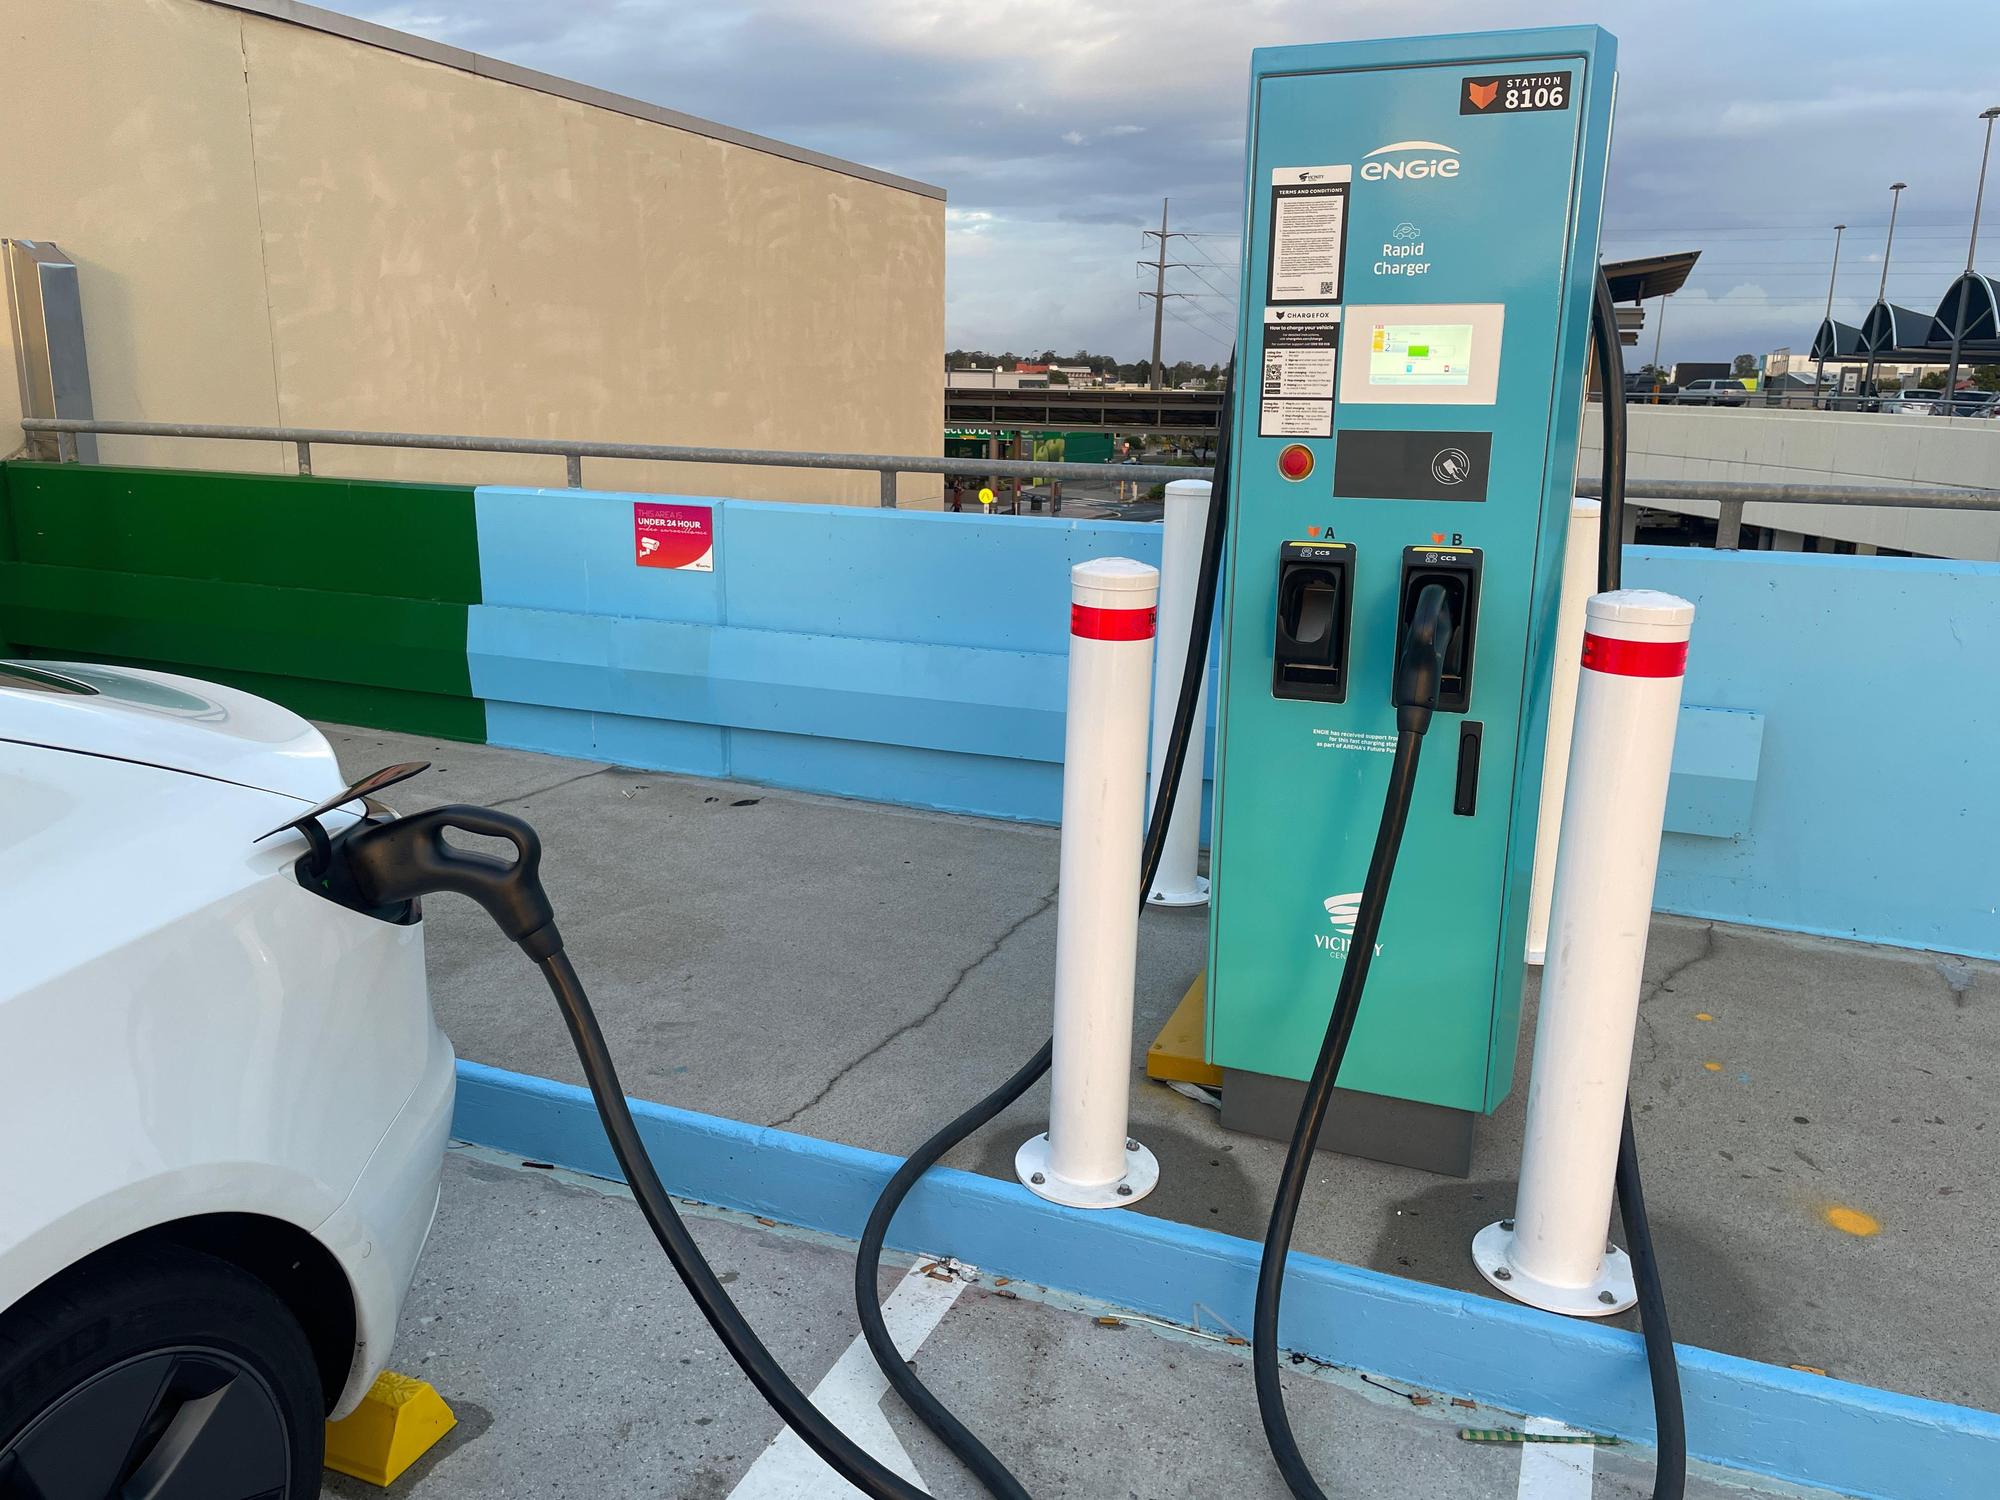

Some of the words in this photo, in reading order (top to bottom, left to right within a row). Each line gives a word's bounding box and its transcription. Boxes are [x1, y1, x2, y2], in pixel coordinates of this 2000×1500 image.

[1507, 76, 1561, 88] STATION
[1505, 88, 1563, 109] 8106
[1382, 242, 1425, 258] Rapid
[1373, 261, 1431, 279] Charger
[1385, 343, 1392, 352] 2
[638, 510, 654, 518] THIS
[637, 517, 666, 527] UNDER
[678, 520, 702, 528] HOUR
[1324, 527, 1335, 540] A
[1452, 534, 1463, 546] B
